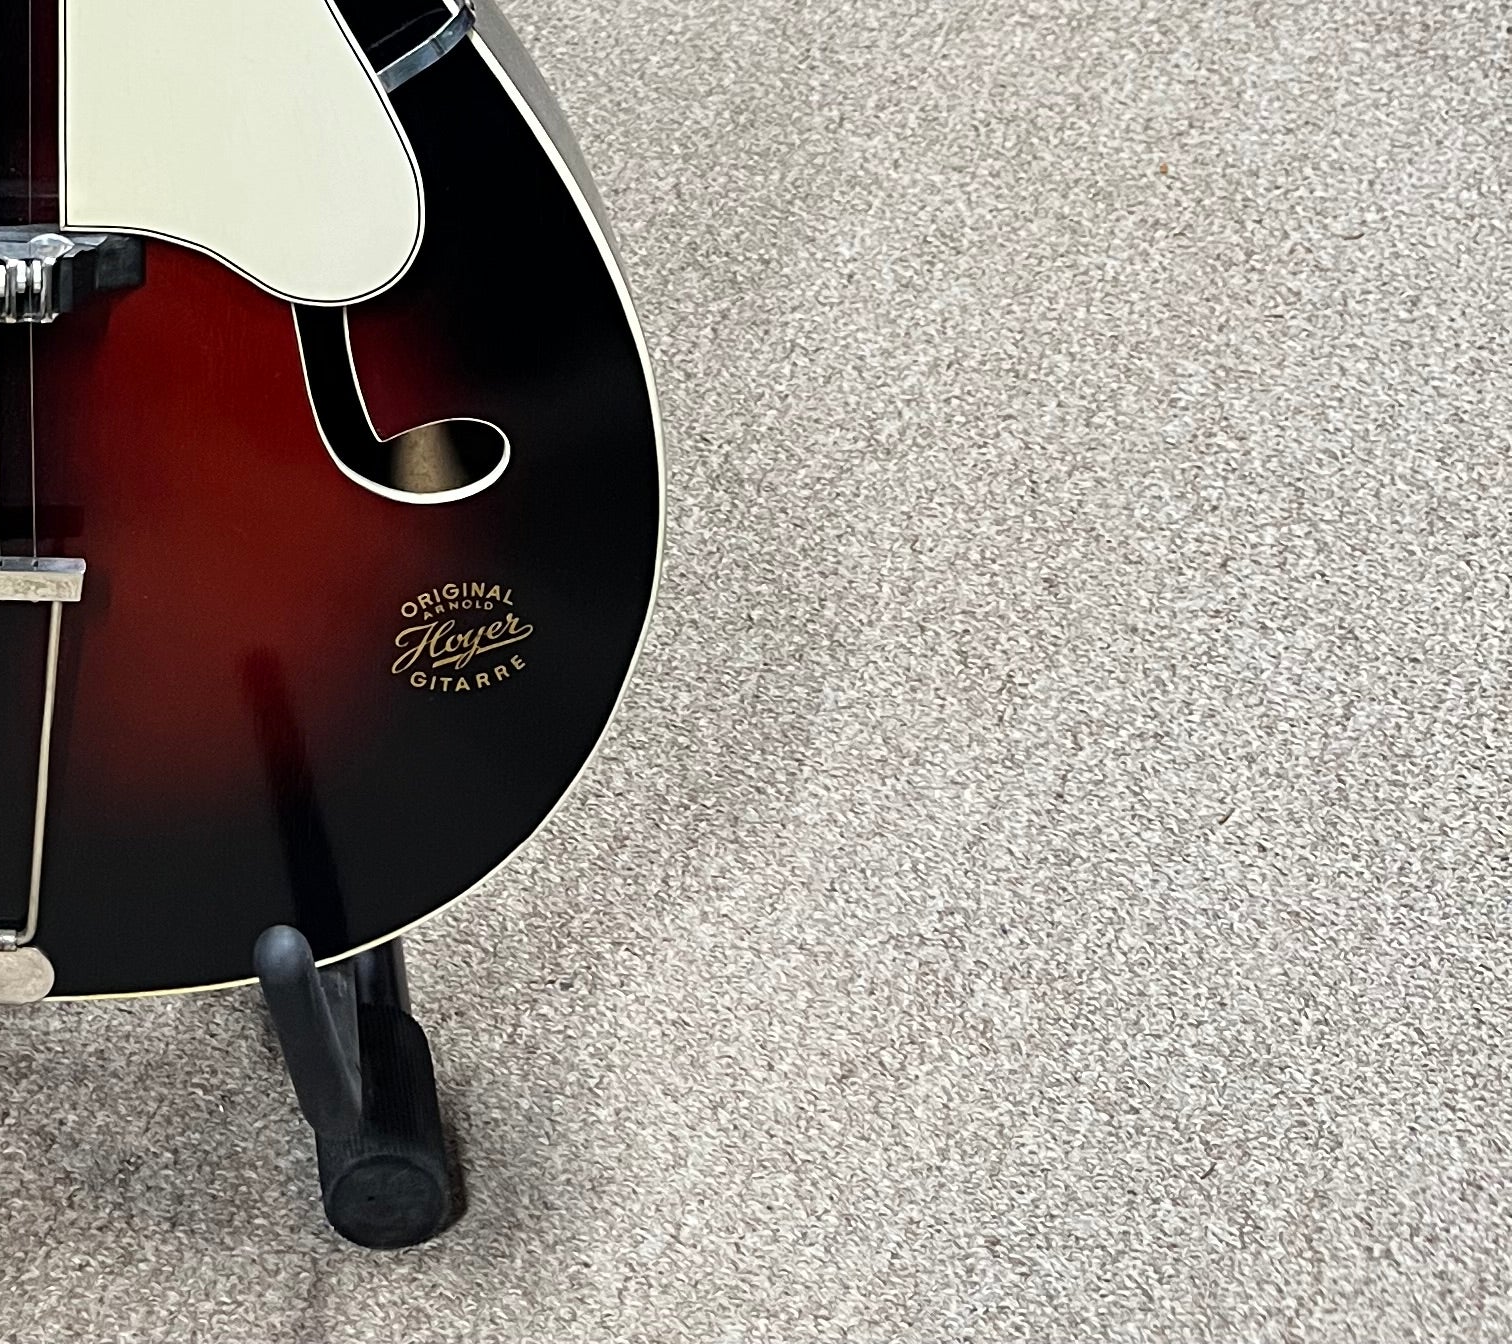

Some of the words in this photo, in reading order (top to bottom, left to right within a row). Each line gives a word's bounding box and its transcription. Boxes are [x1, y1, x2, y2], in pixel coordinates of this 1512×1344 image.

[400, 582, 514, 618] ORIGINAL
[423, 599, 494, 621] ARNOLD
[391, 613, 534, 674] Hoyer
[410, 654, 526, 692] GITARRE
